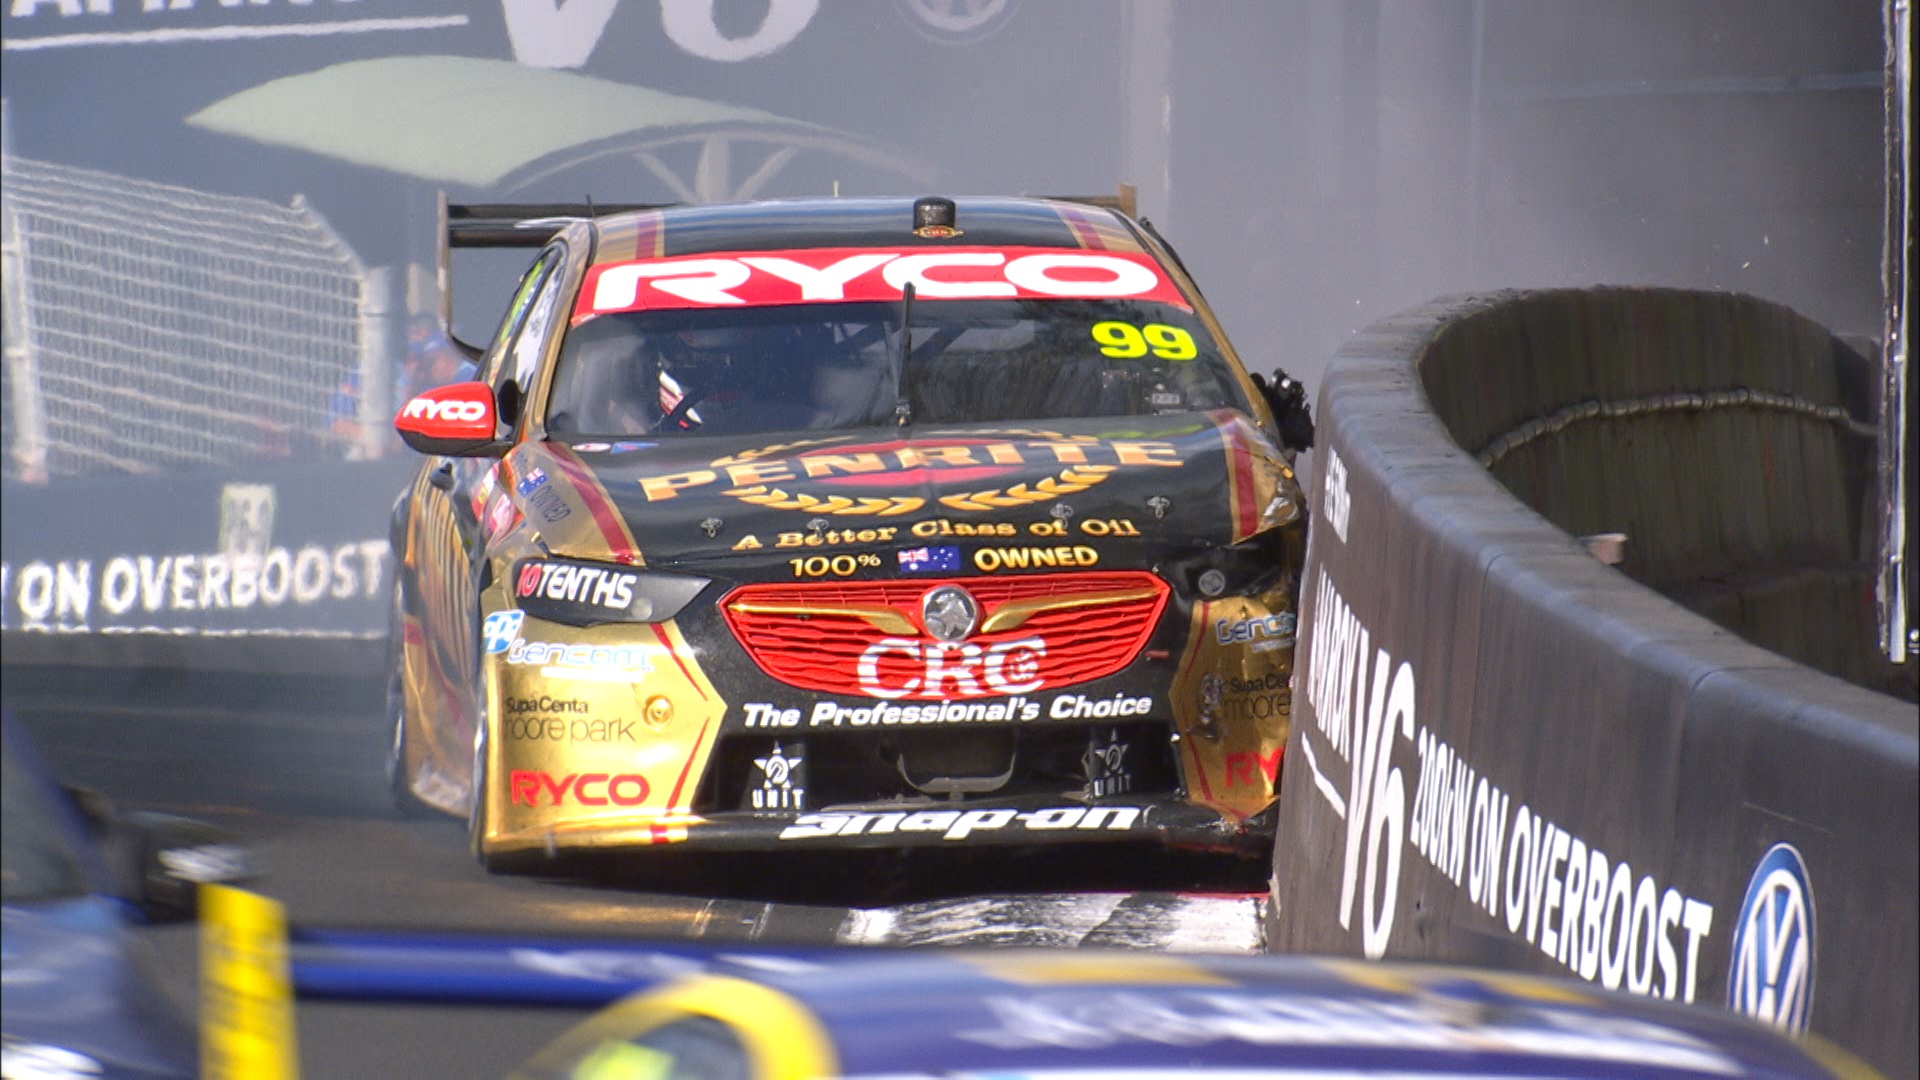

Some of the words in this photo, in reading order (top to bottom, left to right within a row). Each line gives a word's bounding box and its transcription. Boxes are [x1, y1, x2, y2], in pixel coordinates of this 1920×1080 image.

[593, 253, 1158, 309] RYCO
[1092, 321, 1198, 360] 99
[402, 398, 486, 421] RYCO
[638, 441, 1185, 501] PENRITE
[731, 533, 762, 551] A
[774, 526, 898, 547] Better
[911, 518, 1017, 537] Class
[1028, 518, 1068, 537] of
[1080, 518, 1142, 537] Oil
[18, 560, 91, 619] ON
[100, 539, 391, 614] OVERBOOST
[789, 552, 882, 578] 100%
[974, 545, 1099, 572] OWNED
[857, 636, 1047, 698] CRC
[743, 702, 801, 729] The
[809, 697, 1040, 727] Professional's
[1050, 692, 1152, 720] Choice
[570, 717, 637, 745] park
[1225, 747, 1284, 788] RY
[1307, 562, 1361, 763] AMAROK
[1339, 626, 1415, 960] V6
[510, 769, 650, 808] RYCO
[752, 788, 804, 810] UNIT
[1410, 725, 1475, 888] 200kW
[1469, 776, 1510, 918] ON
[1506, 804, 1714, 1004] OVERBOOST
